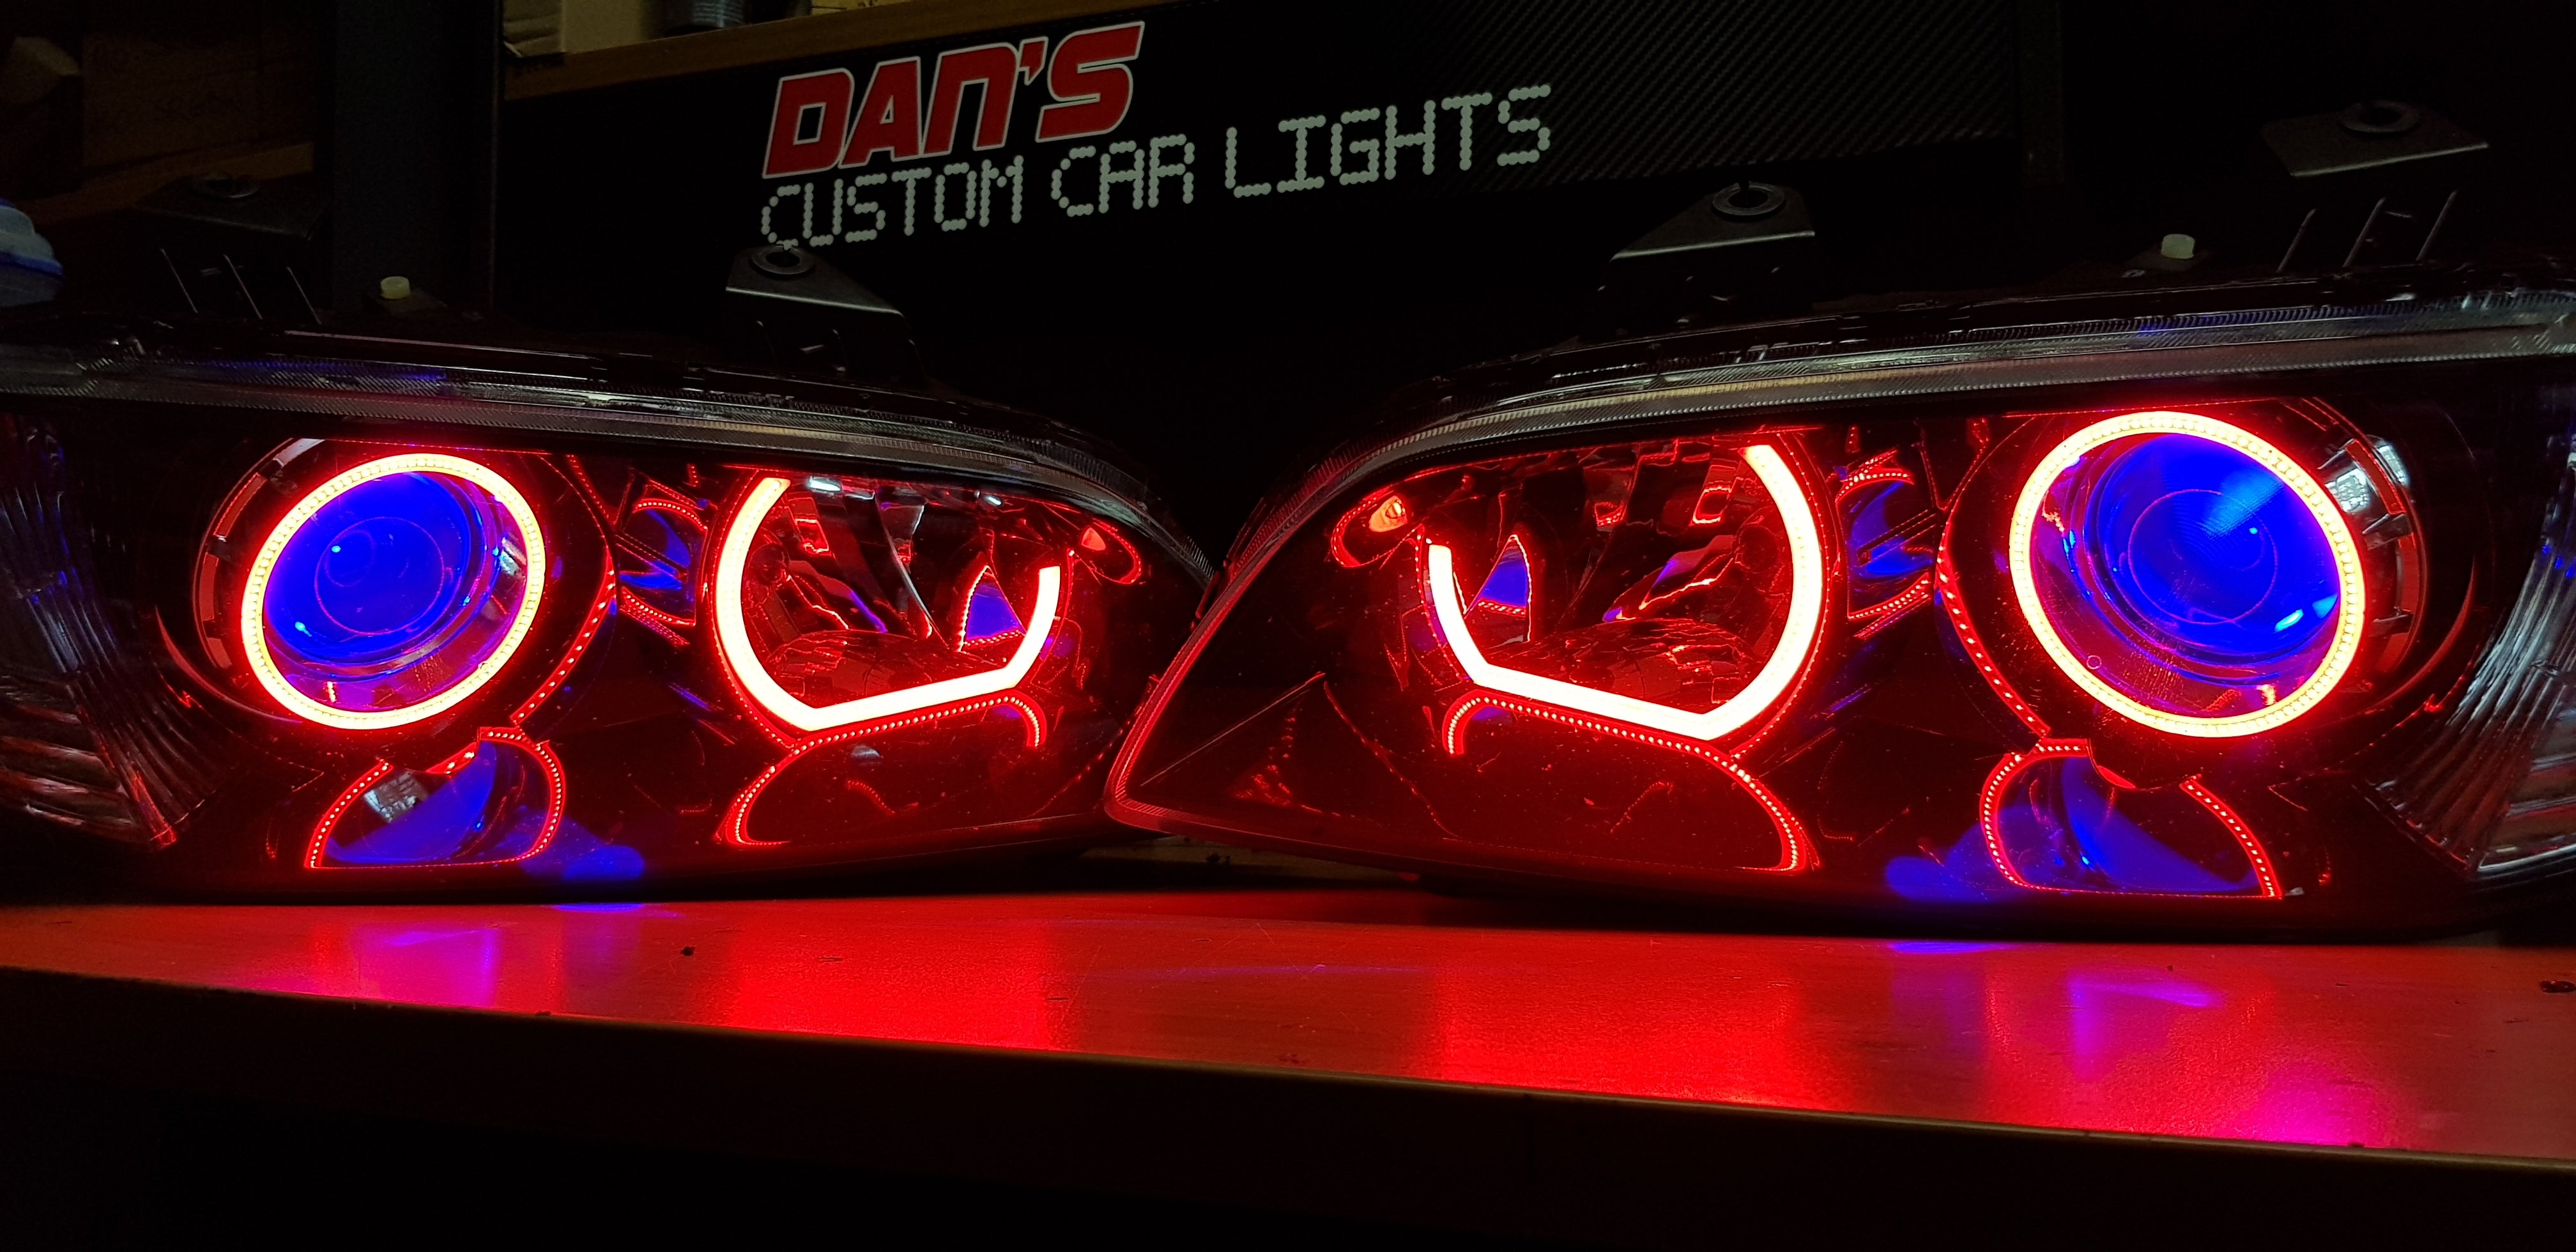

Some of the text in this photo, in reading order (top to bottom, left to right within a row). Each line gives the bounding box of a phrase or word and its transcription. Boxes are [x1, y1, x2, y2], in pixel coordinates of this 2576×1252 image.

[761, 84, 1551, 250] CUSTOM CAR LIGHTS
[762, 21, 1146, 178] DAN'S
